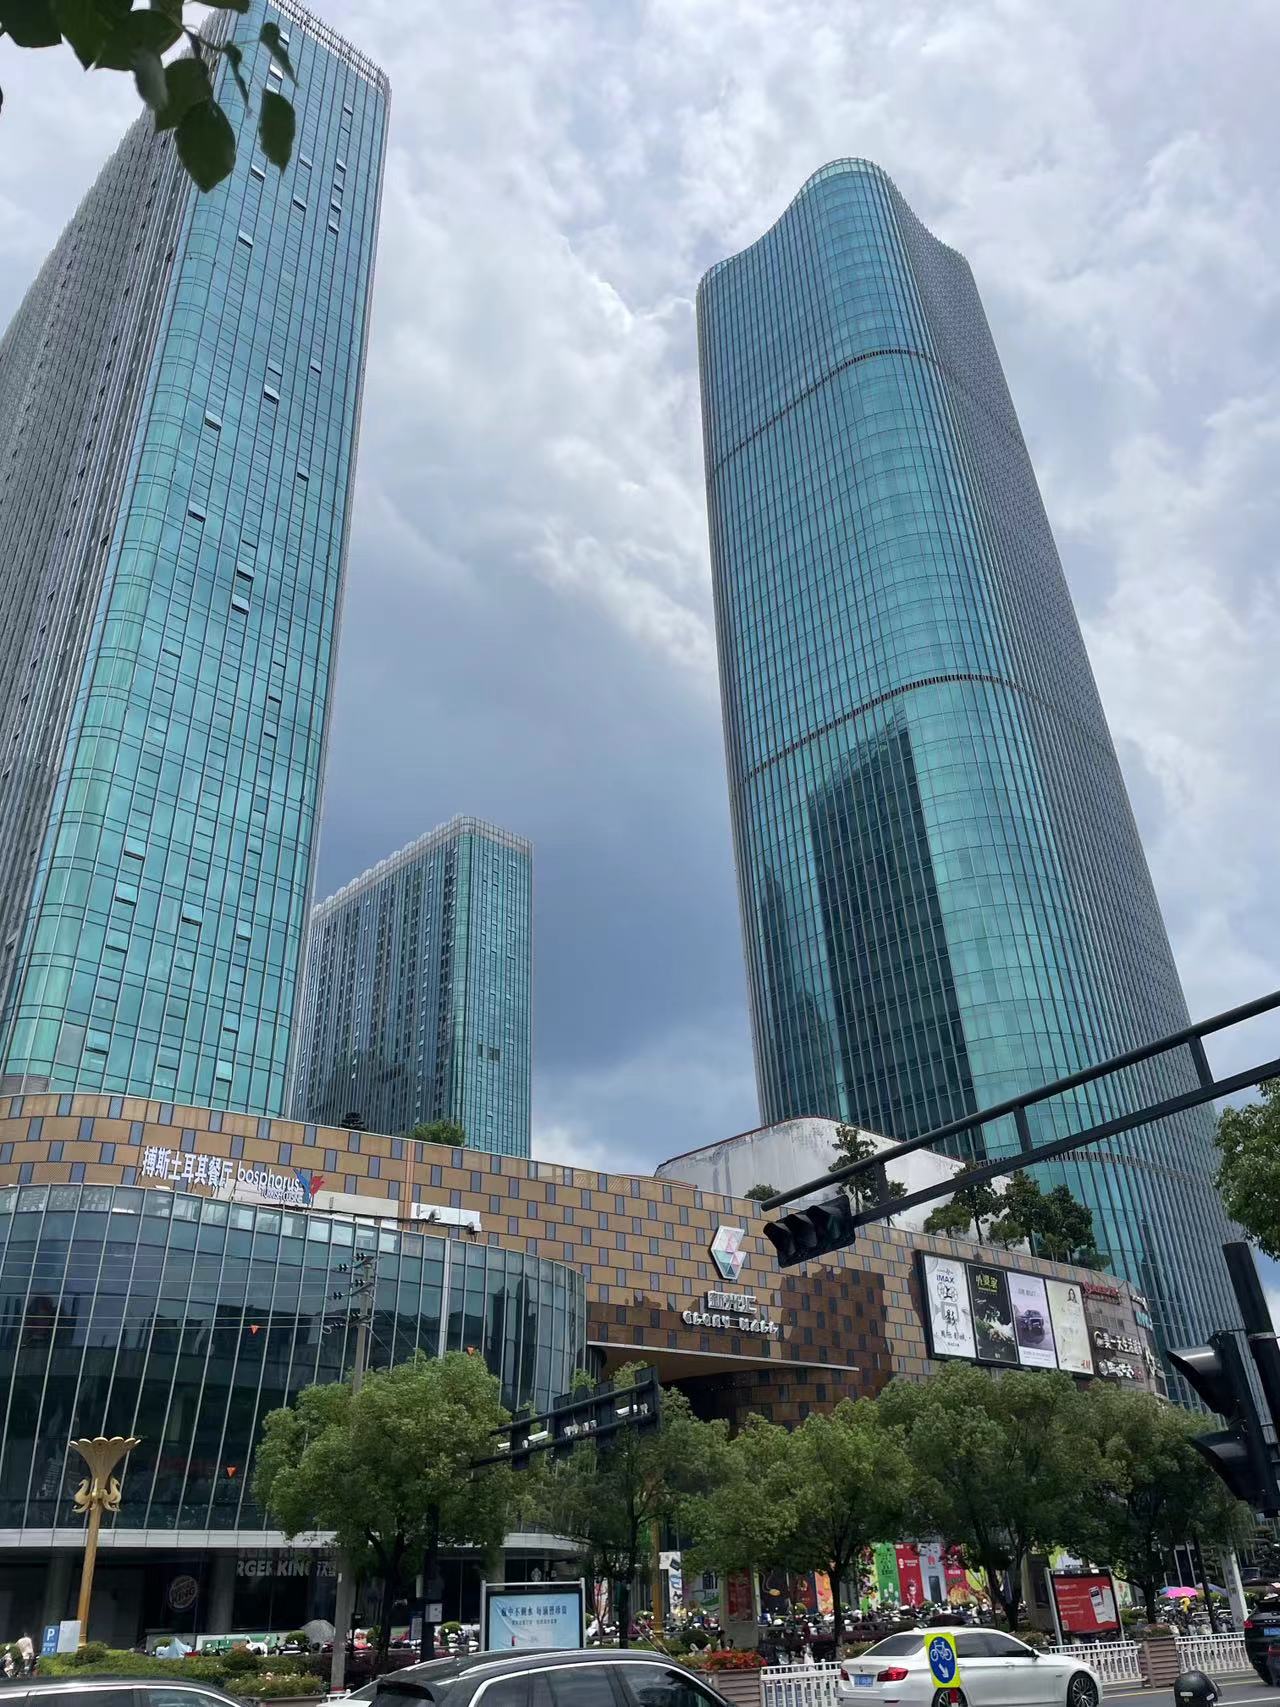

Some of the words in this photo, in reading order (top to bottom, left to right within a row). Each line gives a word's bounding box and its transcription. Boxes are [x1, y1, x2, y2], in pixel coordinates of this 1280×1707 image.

[237, 1161, 300, 1192] bosphorus
[682, 1310, 730, 1328] GLORY
[739, 1317, 779, 1334] MALL
[46, 1628, 55, 1641] P
